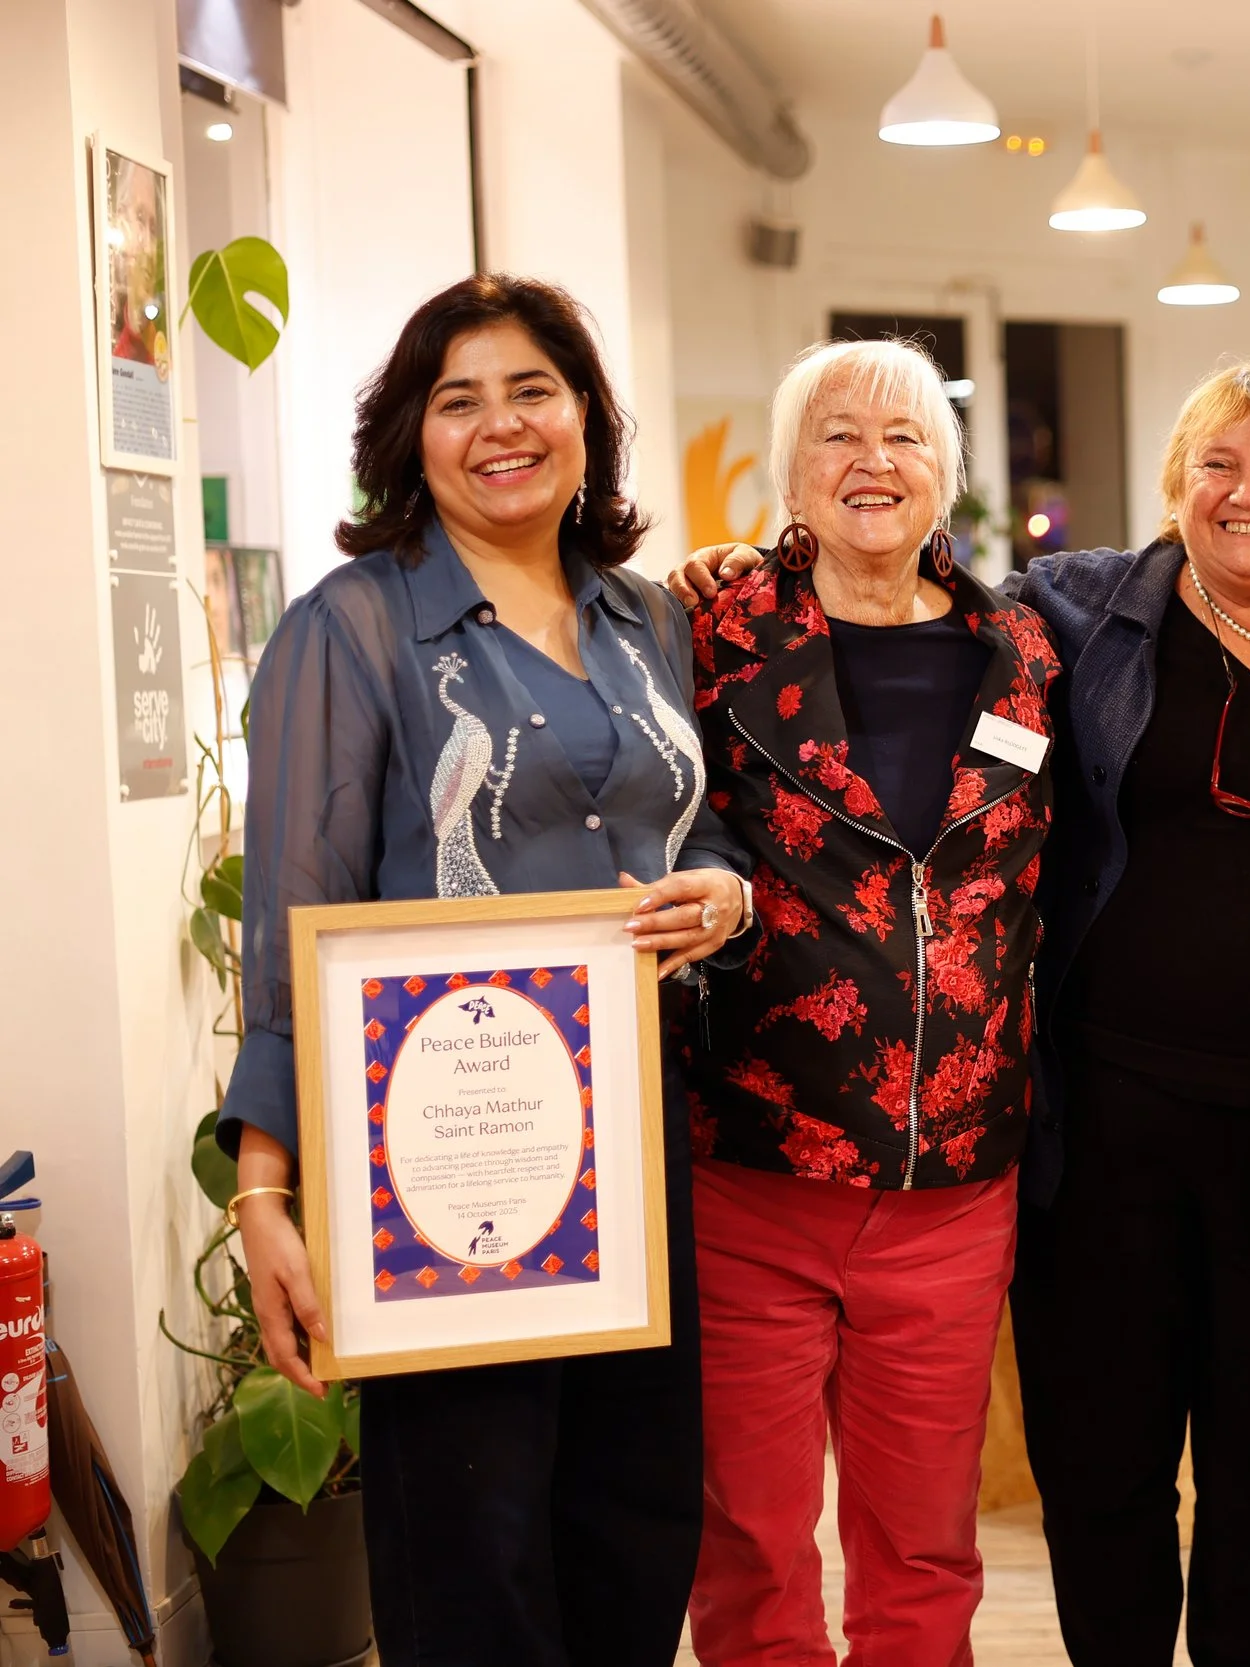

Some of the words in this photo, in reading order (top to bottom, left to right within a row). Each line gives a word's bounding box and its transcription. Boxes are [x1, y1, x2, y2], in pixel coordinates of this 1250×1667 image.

[134, 689, 169, 718] serve
[468, 1000, 491, 1015] PEACE
[421, 1036, 474, 1053] Peace
[480, 1030, 540, 1049] Builder
[454, 1055, 510, 1074] Award
[458, 1086, 496, 1096] Presented
[423, 1104, 480, 1120] Chhaya
[486, 1098, 544, 1114] Mathur
[434, 1124, 475, 1139] Saint
[480, 1120, 534, 1136] Ramon
[400, 1156, 412, 1164] For
[414, 1152, 453, 1162] dedicating
[481, 1148, 520, 1156] knowledge
[522, 1146, 536, 1154] and
[536, 1144, 568, 1153] empathy
[422, 1162, 460, 1171] advancing
[461, 1161, 482, 1170] peace
[484, 1158, 514, 1166] through
[515, 1156, 542, 1164] wisdom
[411, 1173, 456, 1183] compassion
[484, 1166, 516, 1176] heartfelt
[517, 1164, 544, 1174] respect
[406, 1182, 446, 1192] admiration
[448, 1181, 458, 1189] for
[466, 1179, 492, 1188] lifelong
[494, 1176, 519, 1185] service
[448, 1202, 470, 1210] Peace
[472, 1200, 507, 1208] Museums
[509, 1197, 527, 1206] Paris
[467, 1210, 497, 1218] October
[499, 1206, 518, 1216] 2025
